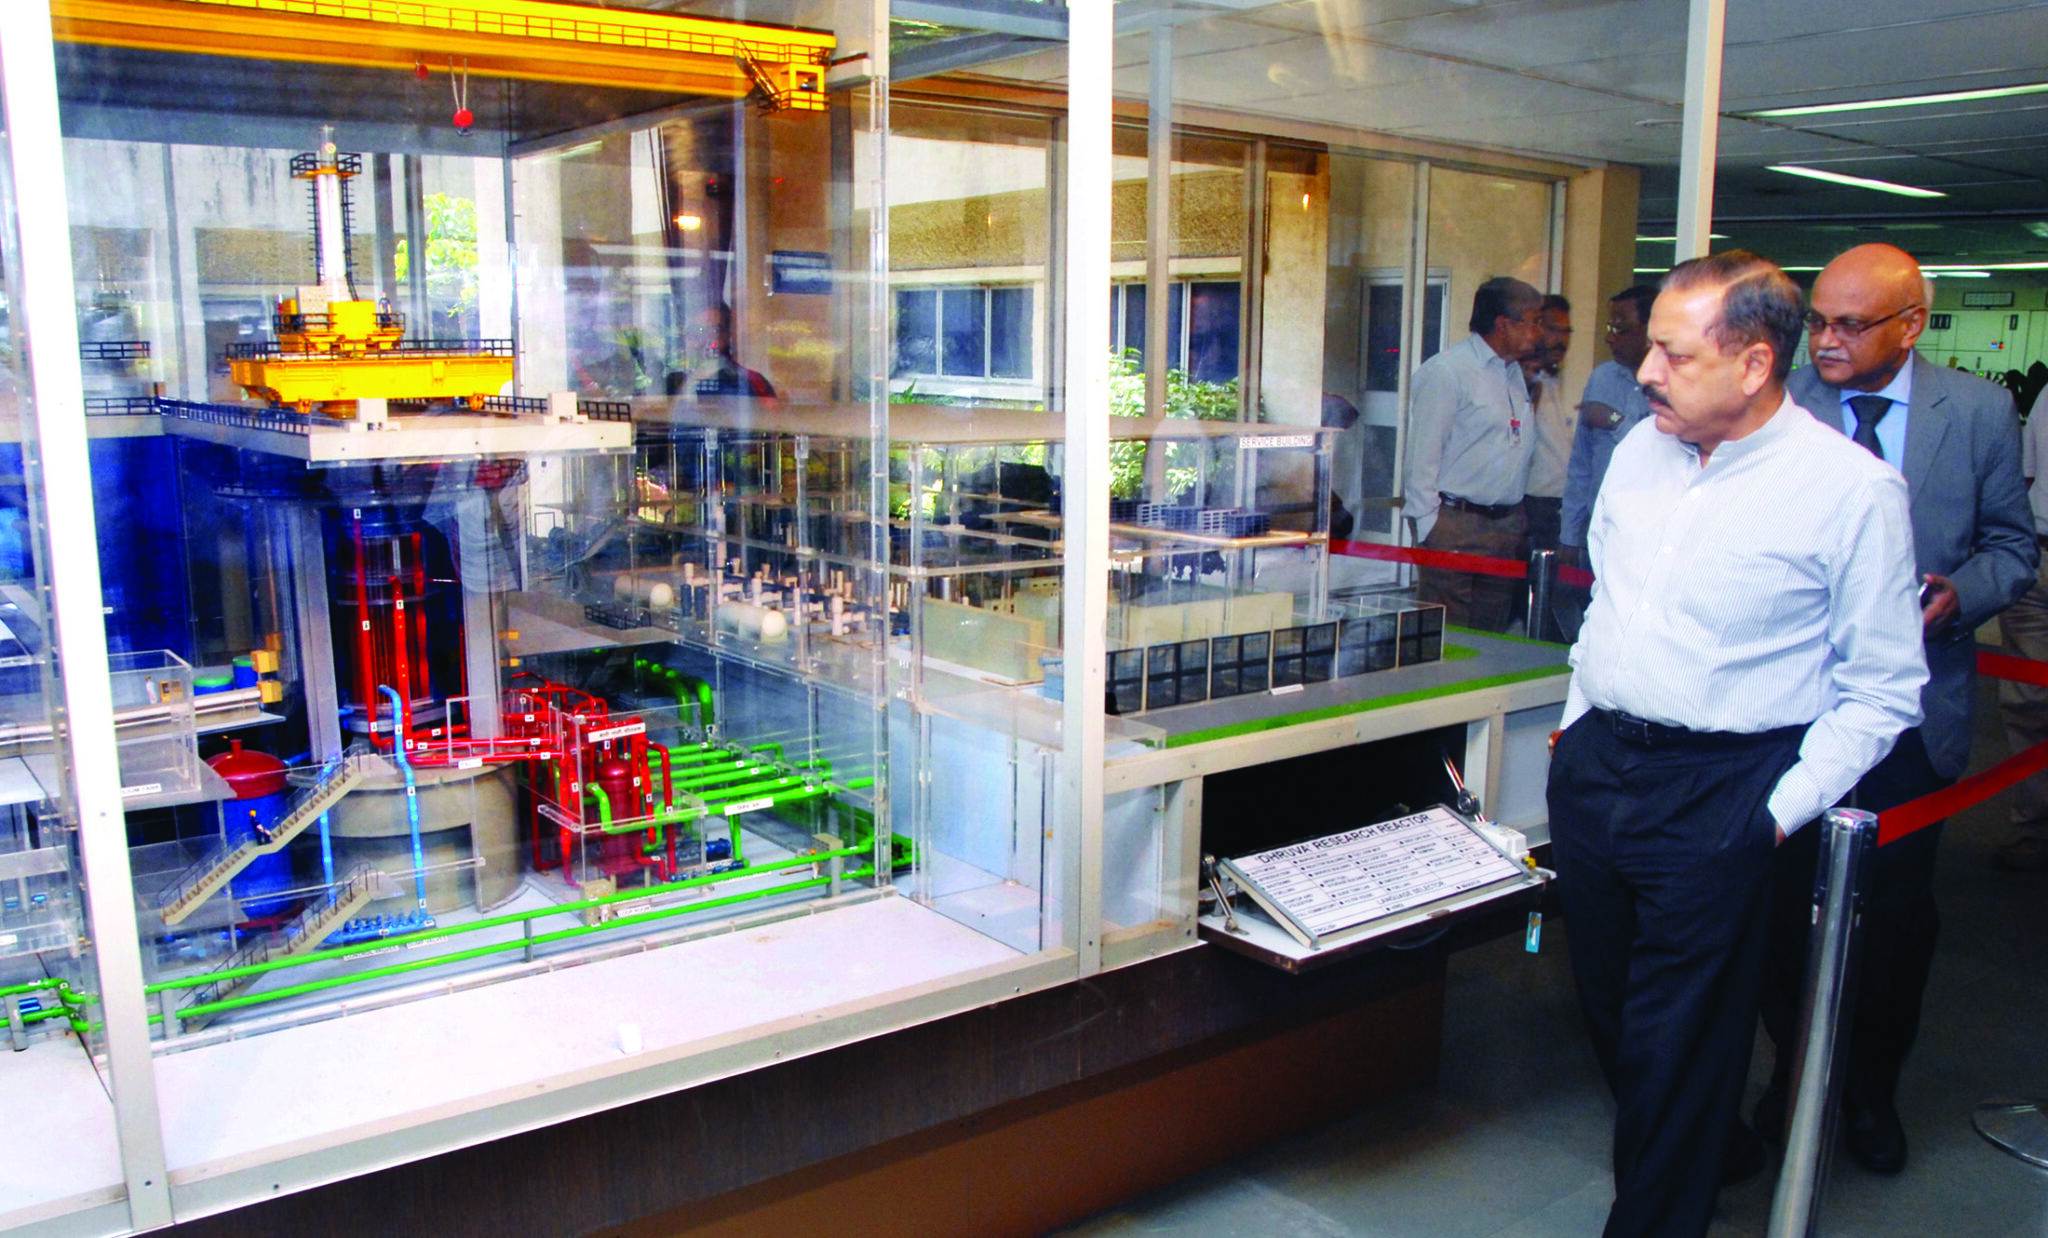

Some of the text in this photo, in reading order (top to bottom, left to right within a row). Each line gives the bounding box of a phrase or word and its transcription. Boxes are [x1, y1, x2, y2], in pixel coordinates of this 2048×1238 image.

[1241, 437, 1274, 448] SERVICE
[1312, 828, 1376, 849] RESEARCH
[1377, 814, 1430, 833] REACTOR
